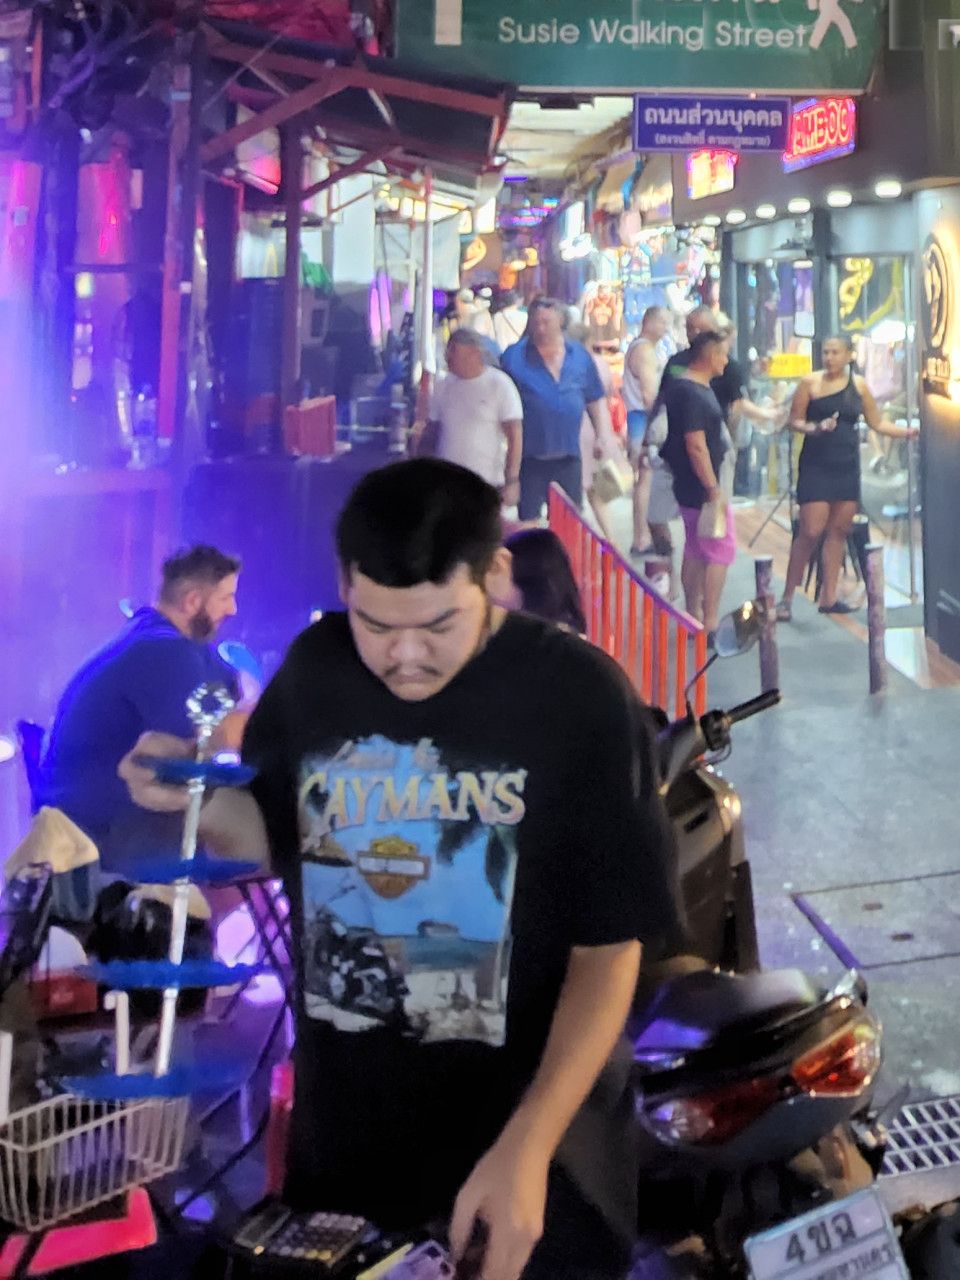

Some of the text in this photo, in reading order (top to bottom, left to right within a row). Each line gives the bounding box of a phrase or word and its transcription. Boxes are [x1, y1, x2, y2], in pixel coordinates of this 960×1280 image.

[499, 17, 807, 51] Susie Walking Street
[644, 103, 783, 133] ถนนส่วนบุคคล
[300, 769, 528, 827] CAYMANS
